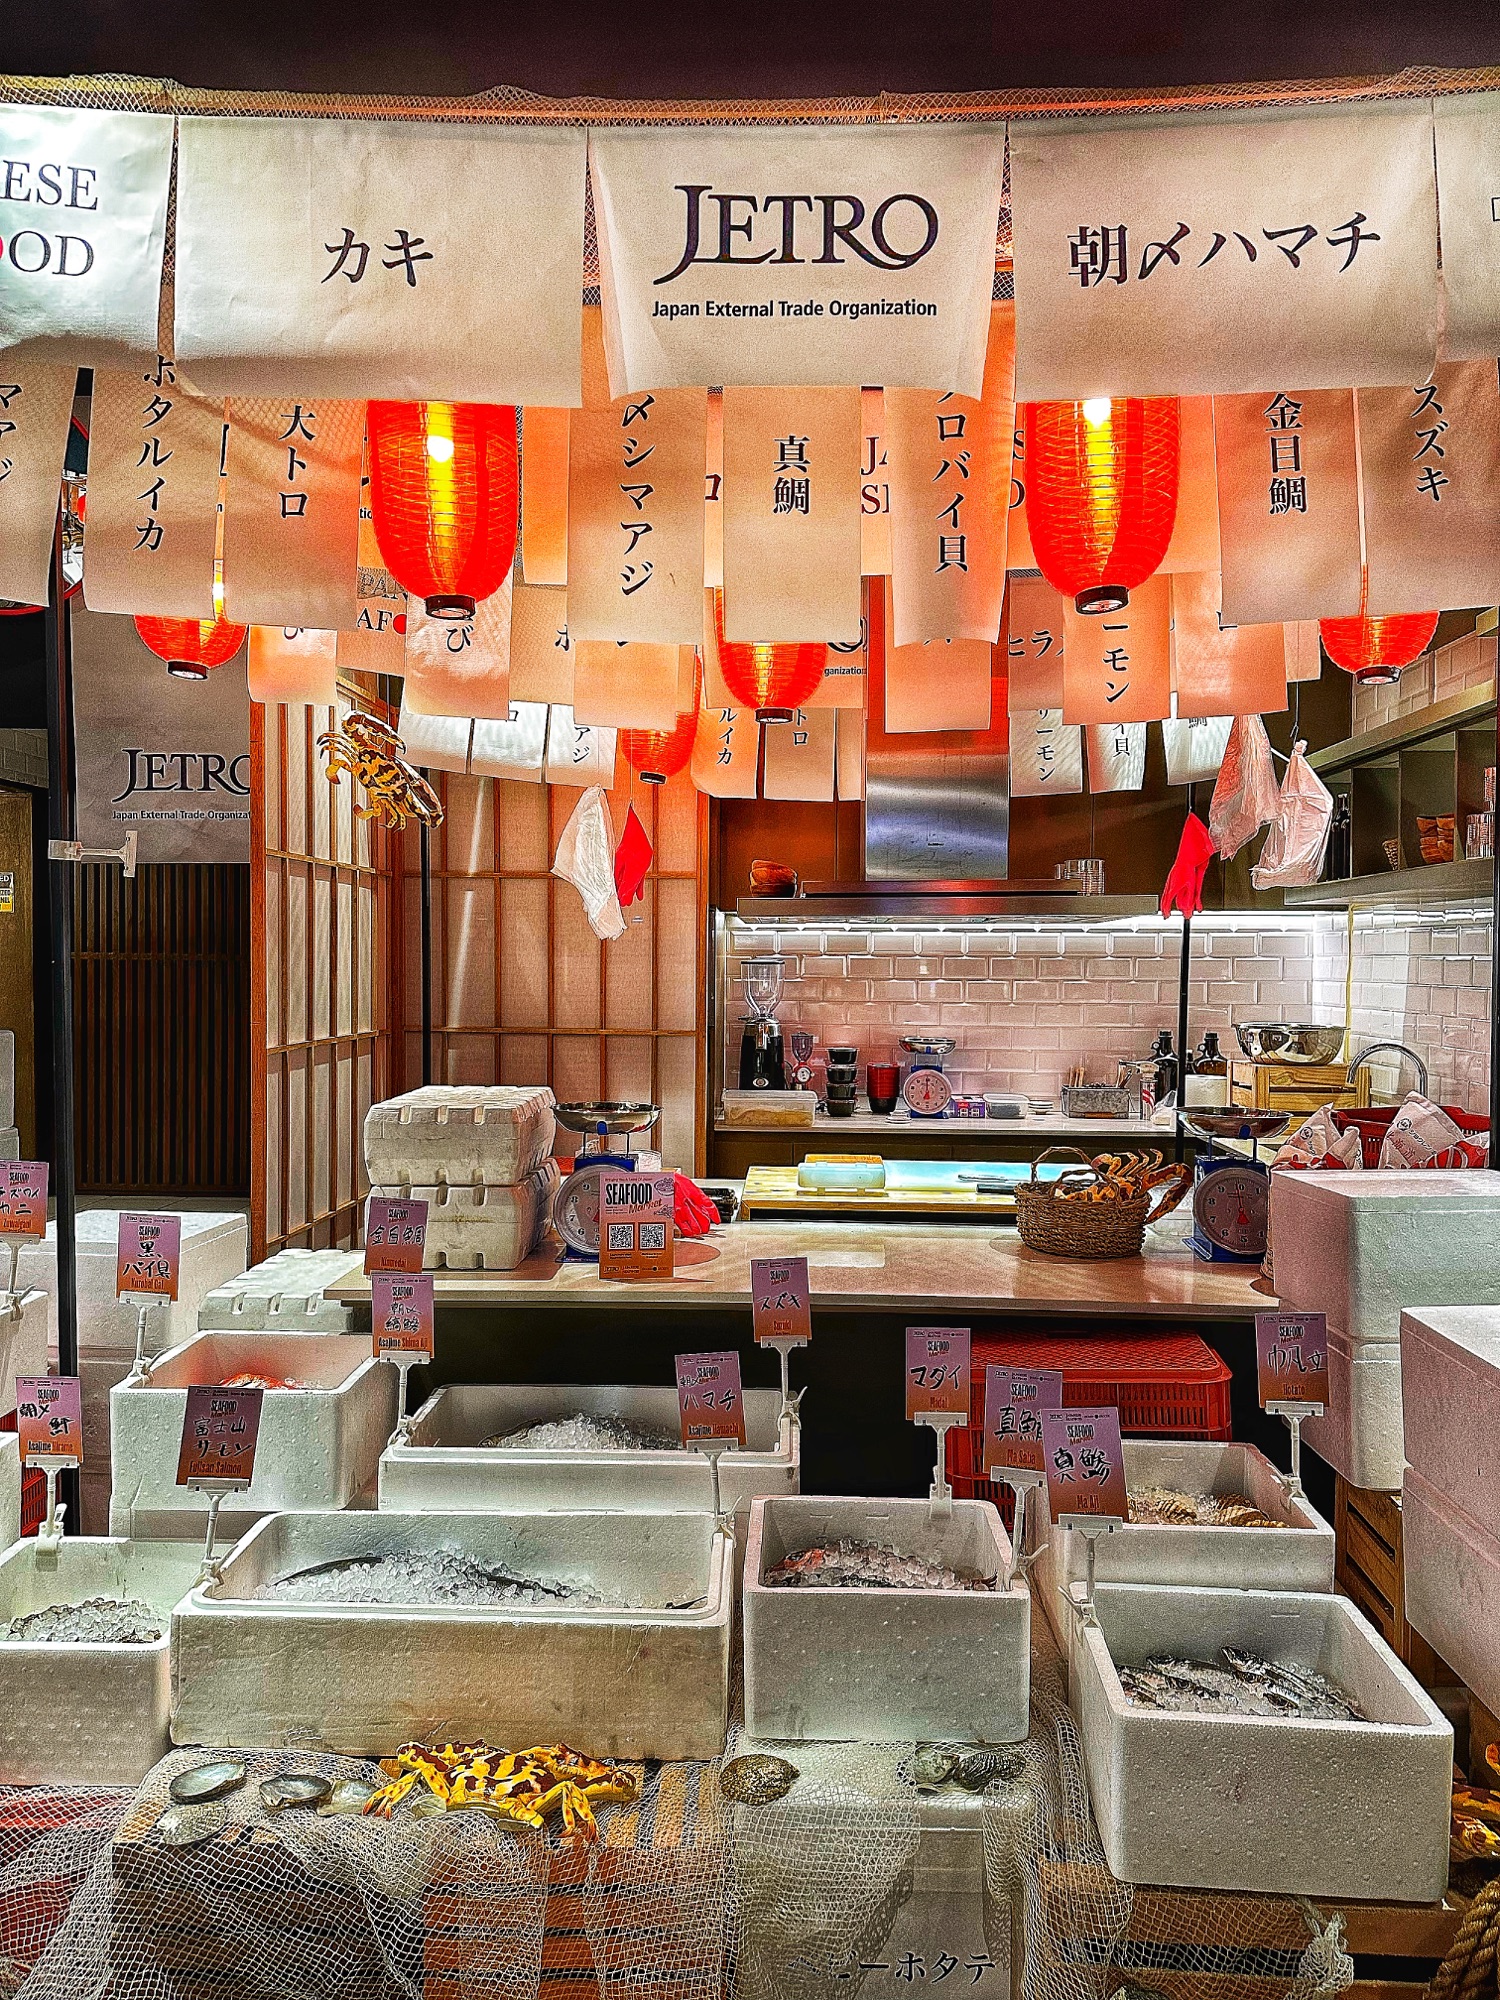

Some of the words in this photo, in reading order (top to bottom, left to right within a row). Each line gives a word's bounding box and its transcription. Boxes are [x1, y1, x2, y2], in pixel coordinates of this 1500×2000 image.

[653, 185, 940, 286] JETRO
[321, 228, 434, 287] カキ
[652, 301, 700, 320] Japan
[706, 301, 774, 317] External
[778, 300, 824, 317] Trade
[829, 299, 937, 320] Organization
[133, 354, 176, 551] ホタルイカ
[1263, 392, 1308, 515] 金目鯛
[1412, 381, 1450, 502] スズキ
[278, 405, 316, 519] 大トロ
[773, 435, 811, 515] 真鯛
[932, 391, 971, 574] ロバイ貝
[112, 811, 138, 822] Japan
[140, 810, 178, 820] External
[180, 810, 205, 820] Trade
[606, 1183, 653, 1205] SEAFOOD
[628, 1198, 663, 1214] Market
[1279, 1325, 1305, 1337] SEAFOOD
[910, 1364, 961, 1390] マダイ
[683, 1388, 736, 1412] ハマチ
[1011, 1383, 1037, 1397] SEAFOOD
[210, 1399, 238, 1412] SEAFOOD
[1066, 1424, 1094, 1438] SEAFOOD
[215, 1461, 242, 1474] Salmon
